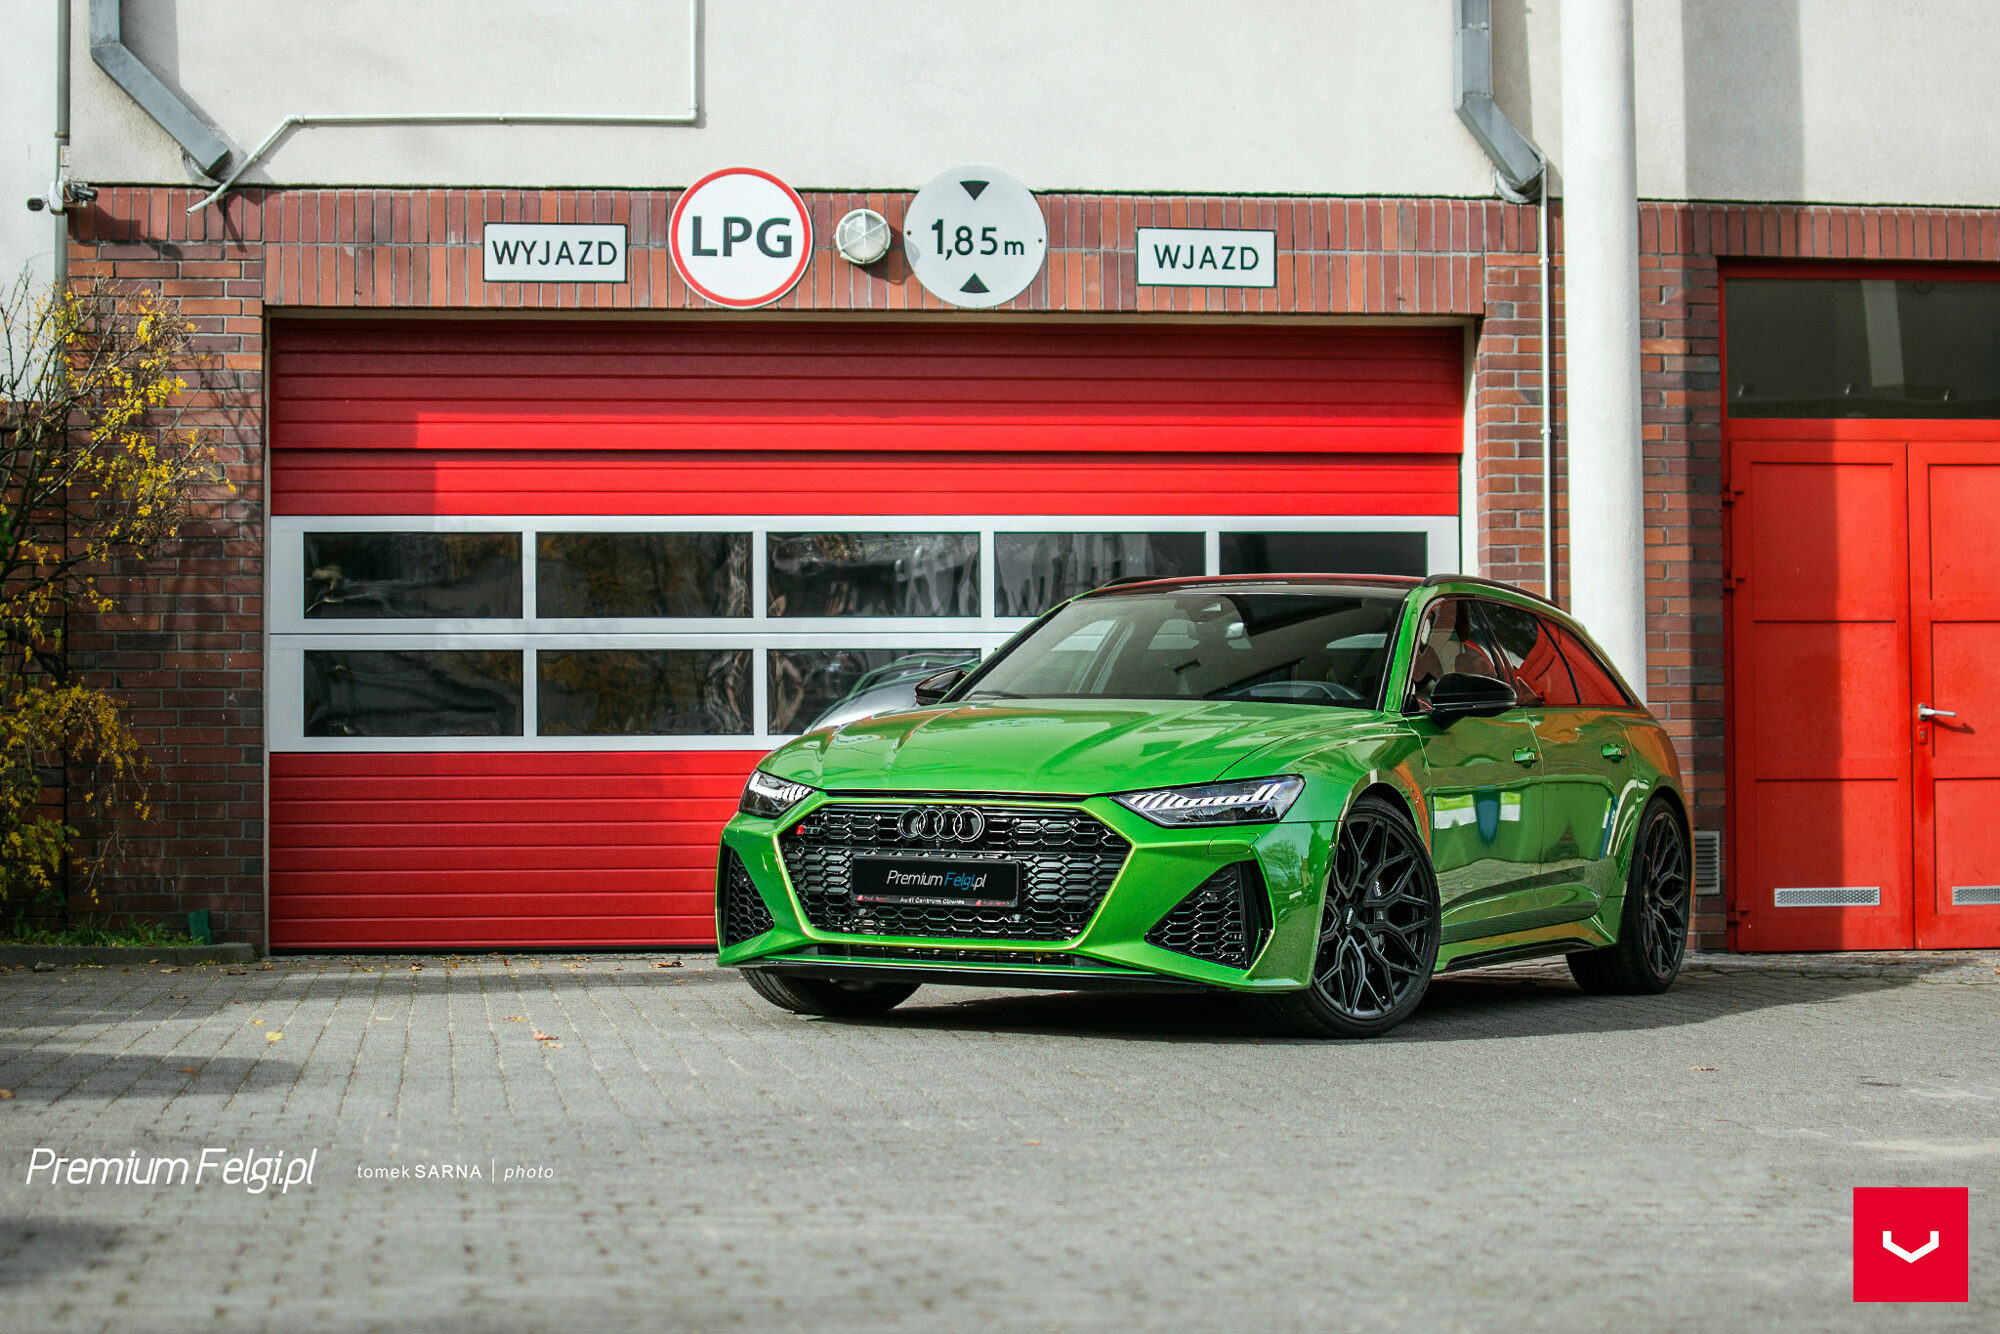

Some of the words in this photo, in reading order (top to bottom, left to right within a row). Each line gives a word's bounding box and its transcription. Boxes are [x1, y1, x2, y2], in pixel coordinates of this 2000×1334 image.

[691, 215, 793, 259] LPG
[492, 240, 618, 266] WYJAZD
[1153, 244, 1260, 271] WJAZD
[886, 869, 943, 887] Premium
[943, 871, 988, 892] Felgi.pl
